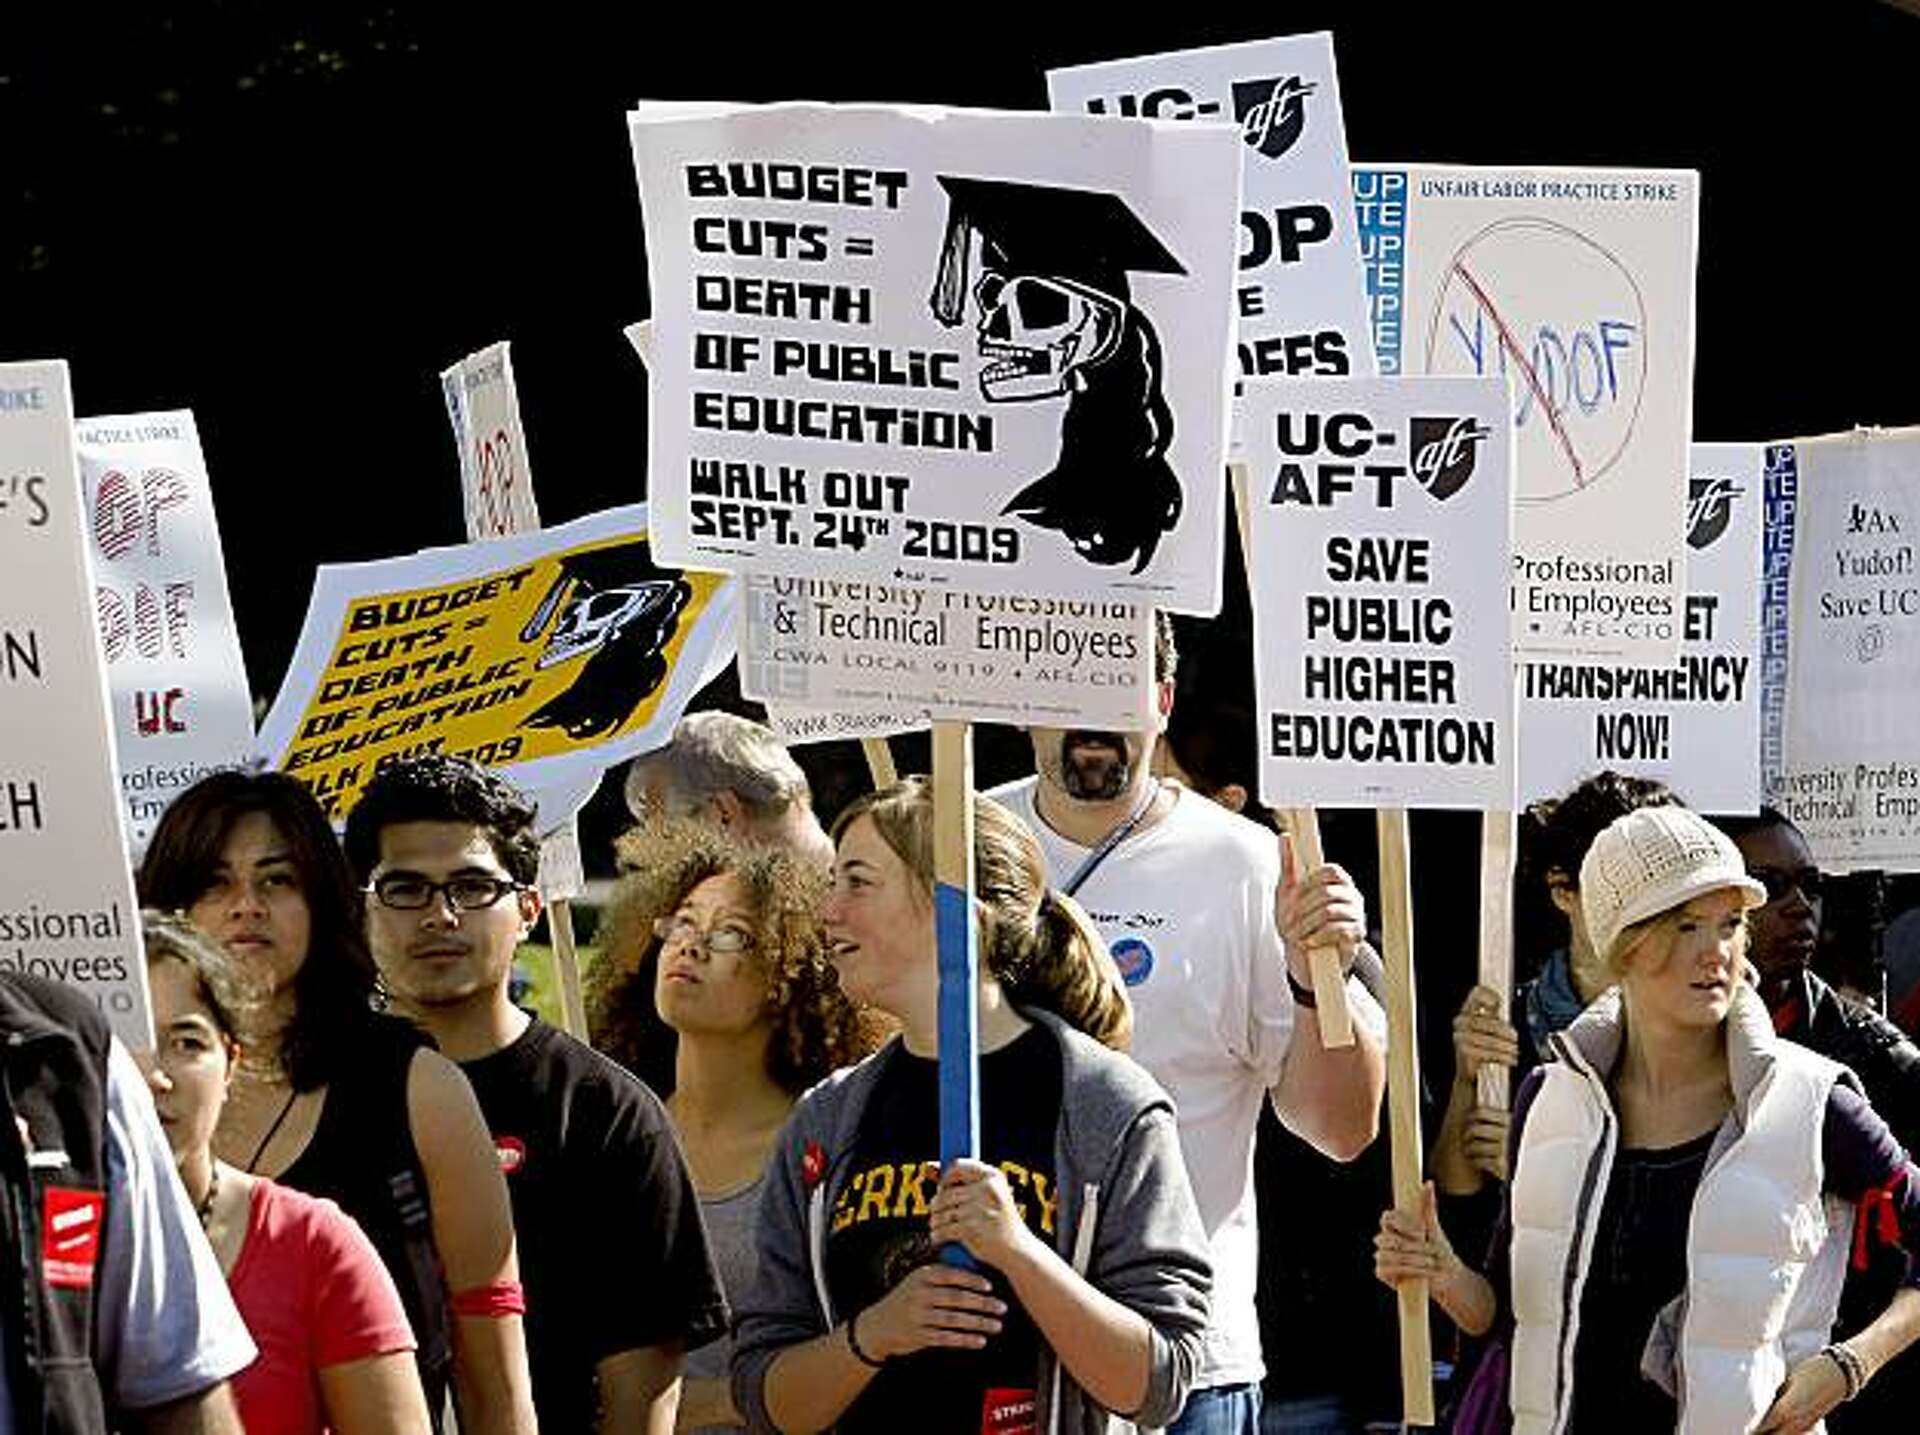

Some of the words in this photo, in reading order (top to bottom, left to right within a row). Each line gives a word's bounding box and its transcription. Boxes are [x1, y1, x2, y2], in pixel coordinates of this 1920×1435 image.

[686, 163, 908, 209] BUDGET
[1421, 181, 1480, 198] UNFAIR
[1483, 181, 1537, 198] LABOR
[1541, 183, 1619, 200] PRACTICE
[1624, 184, 1678, 201] STRIKE
[694, 217, 828, 262] CUTS
[696, 275, 871, 324] DEATH
[694, 333, 760, 372] OF
[1277, 413, 1397, 458] UC-
[690, 458, 807, 504] WALK
[823, 472, 910, 513] OUT
[1270, 464, 1407, 509] AFT
[691, 500, 799, 545] SEPT.
[902, 519, 1019, 563] 2009
[1327, 537, 1430, 583] SAVE
[350, 567, 535, 634] BUDGET
[1306, 596, 1453, 645] PUBLIC
[1529, 587, 1673, 621] Employees
[1821, 591, 1871, 619] Save
[1879, 589, 1918, 615] UC
[335, 621, 453, 668] CUTS
[774, 601, 797, 634] &
[814, 602, 946, 646] Technical
[976, 615, 1138, 668] Employees
[319, 644, 475, 704] DEATH
[773, 649, 828, 666] CWA
[843, 653, 917, 672] LOCAL
[933, 661, 995, 678] 9119
[1305, 656, 1457, 705] HIGHER
[1525, 656, 1749, 702] TRANSPARENCY
[301, 706, 363, 741] OF
[1271, 713, 1497, 766] EDUCATION
[1597, 713, 1669, 760] NOW!
